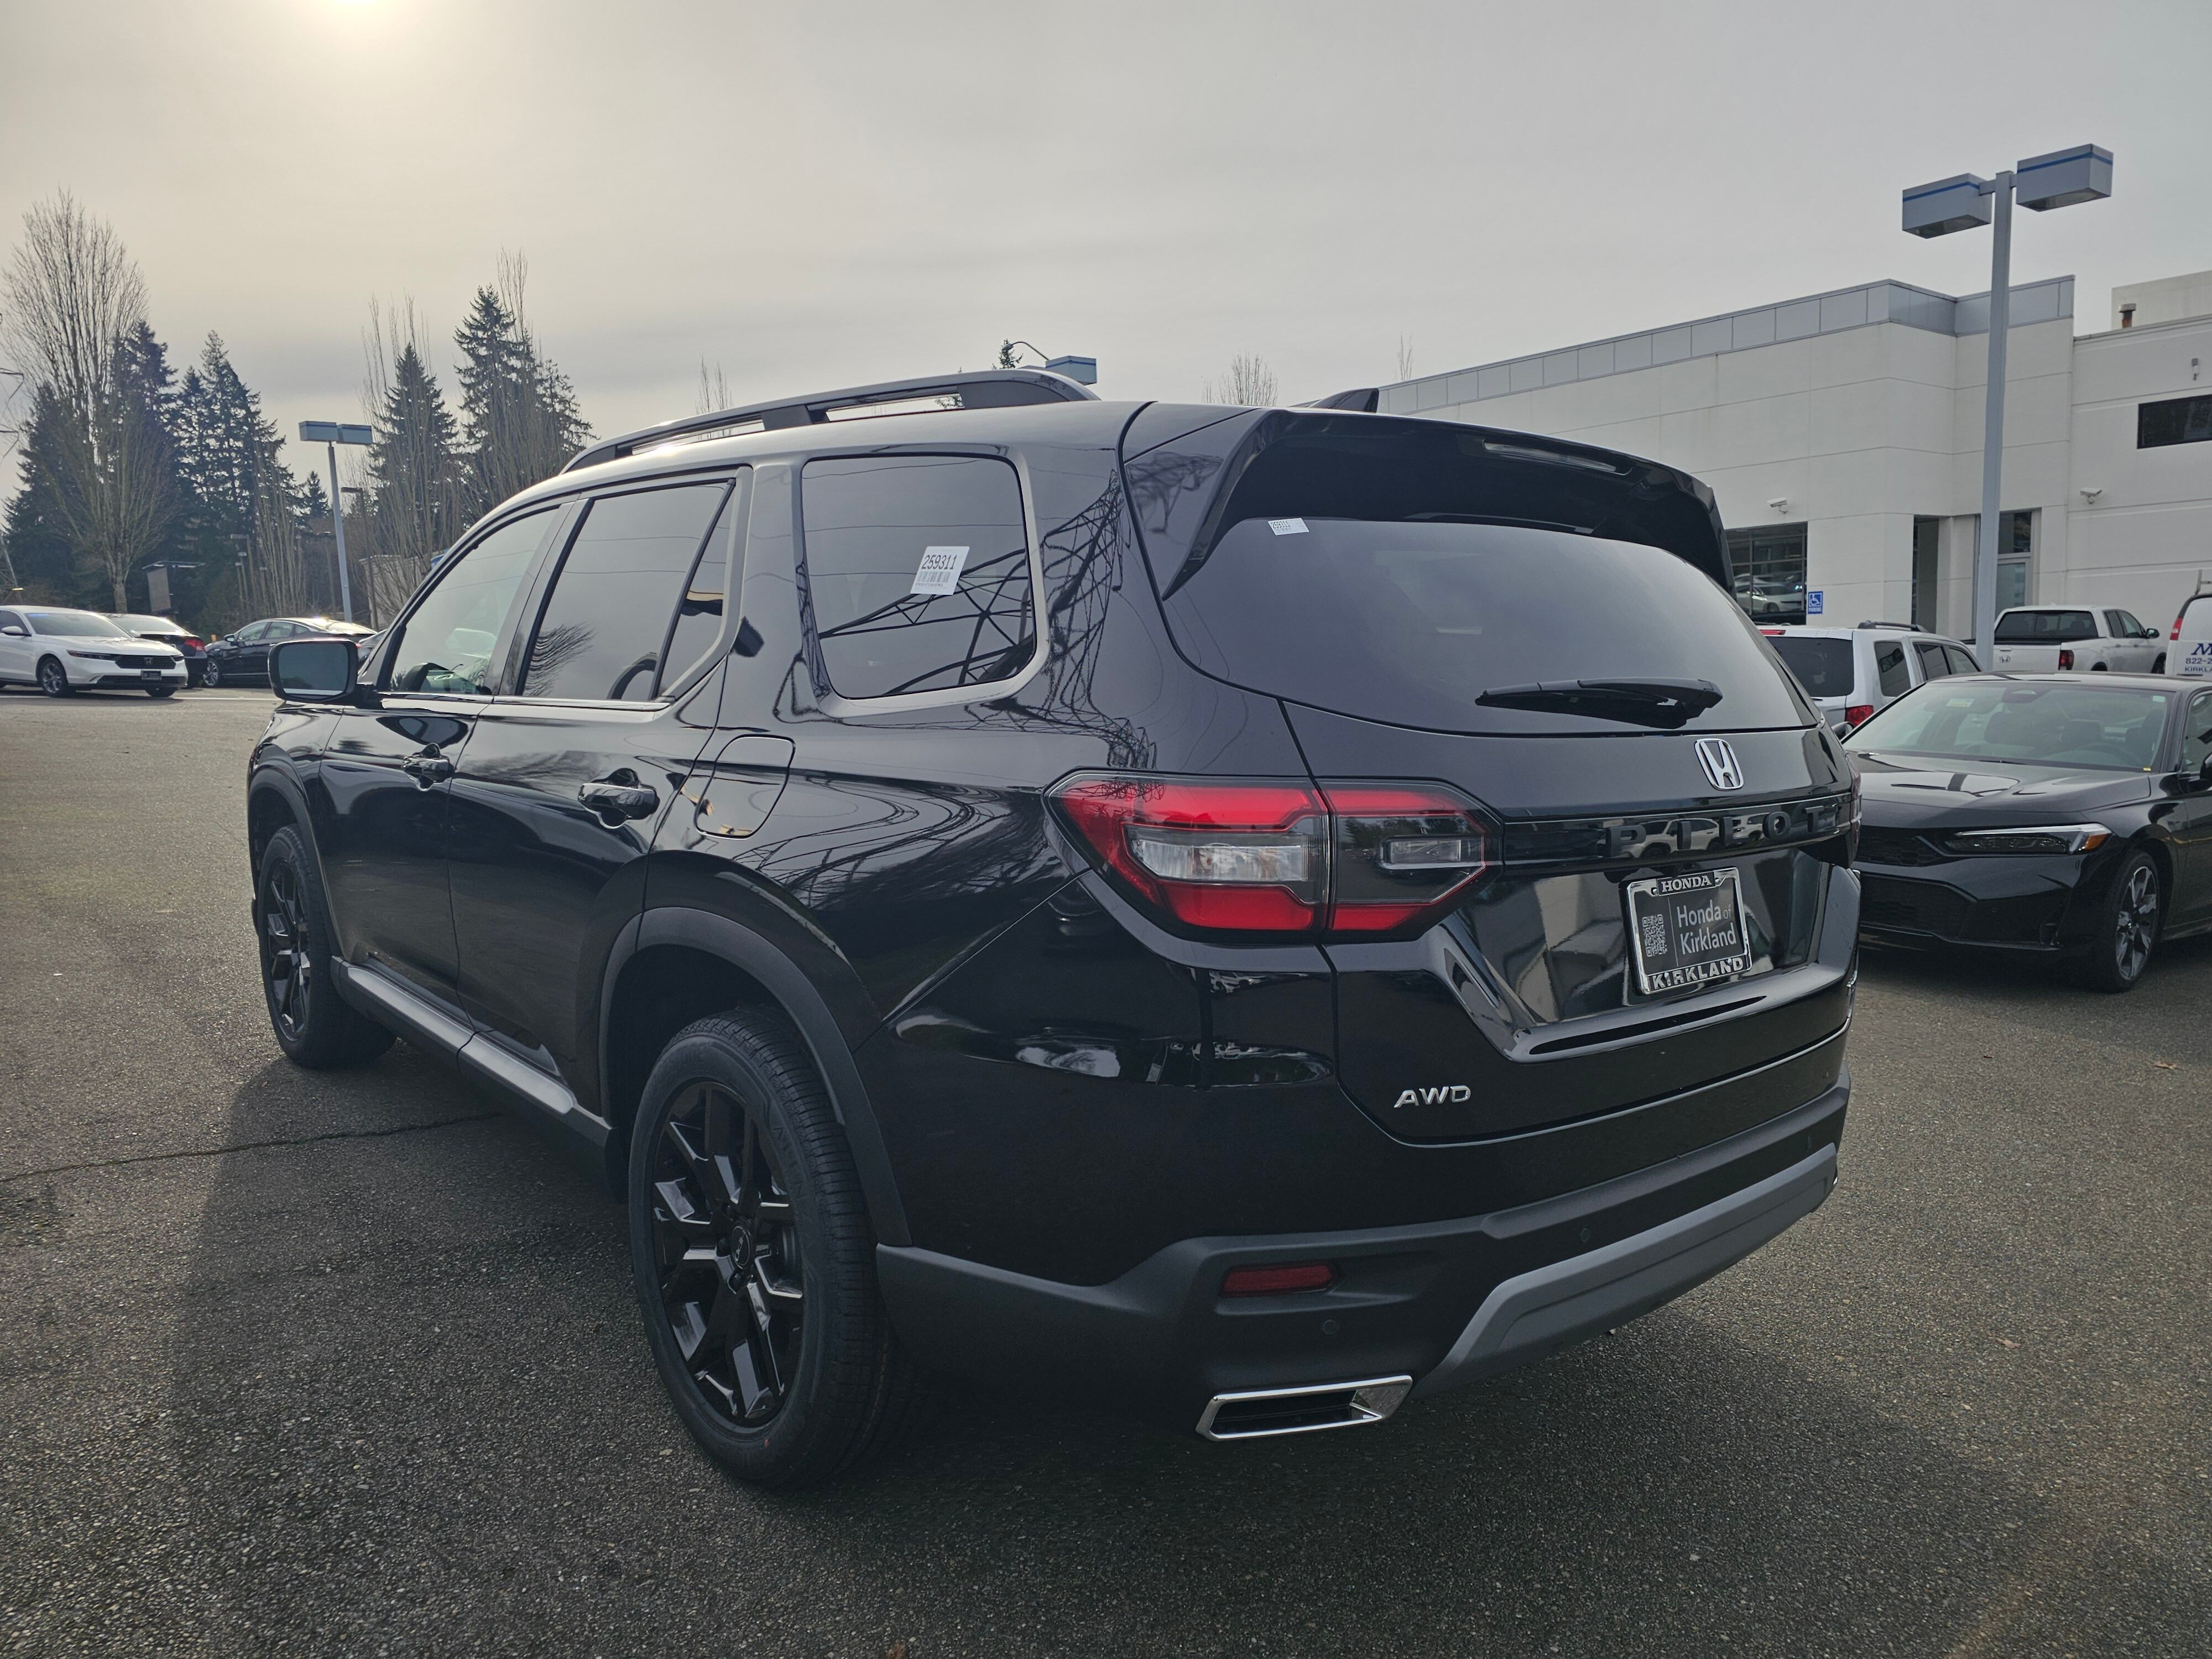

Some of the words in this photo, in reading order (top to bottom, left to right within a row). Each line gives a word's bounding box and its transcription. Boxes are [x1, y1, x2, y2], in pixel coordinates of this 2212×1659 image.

[921, 554, 957, 570] 259311
[1606, 805, 1824, 857] PILOT
[1661, 875, 1712, 893] HONDA
[1677, 899, 1722, 928] Honda
[1723, 904, 1731, 920] of
[1680, 922, 1736, 955] Kirkland
[1652, 957, 1743, 990] KIRKLAND
[1394, 1085, 1472, 1108] AWD
